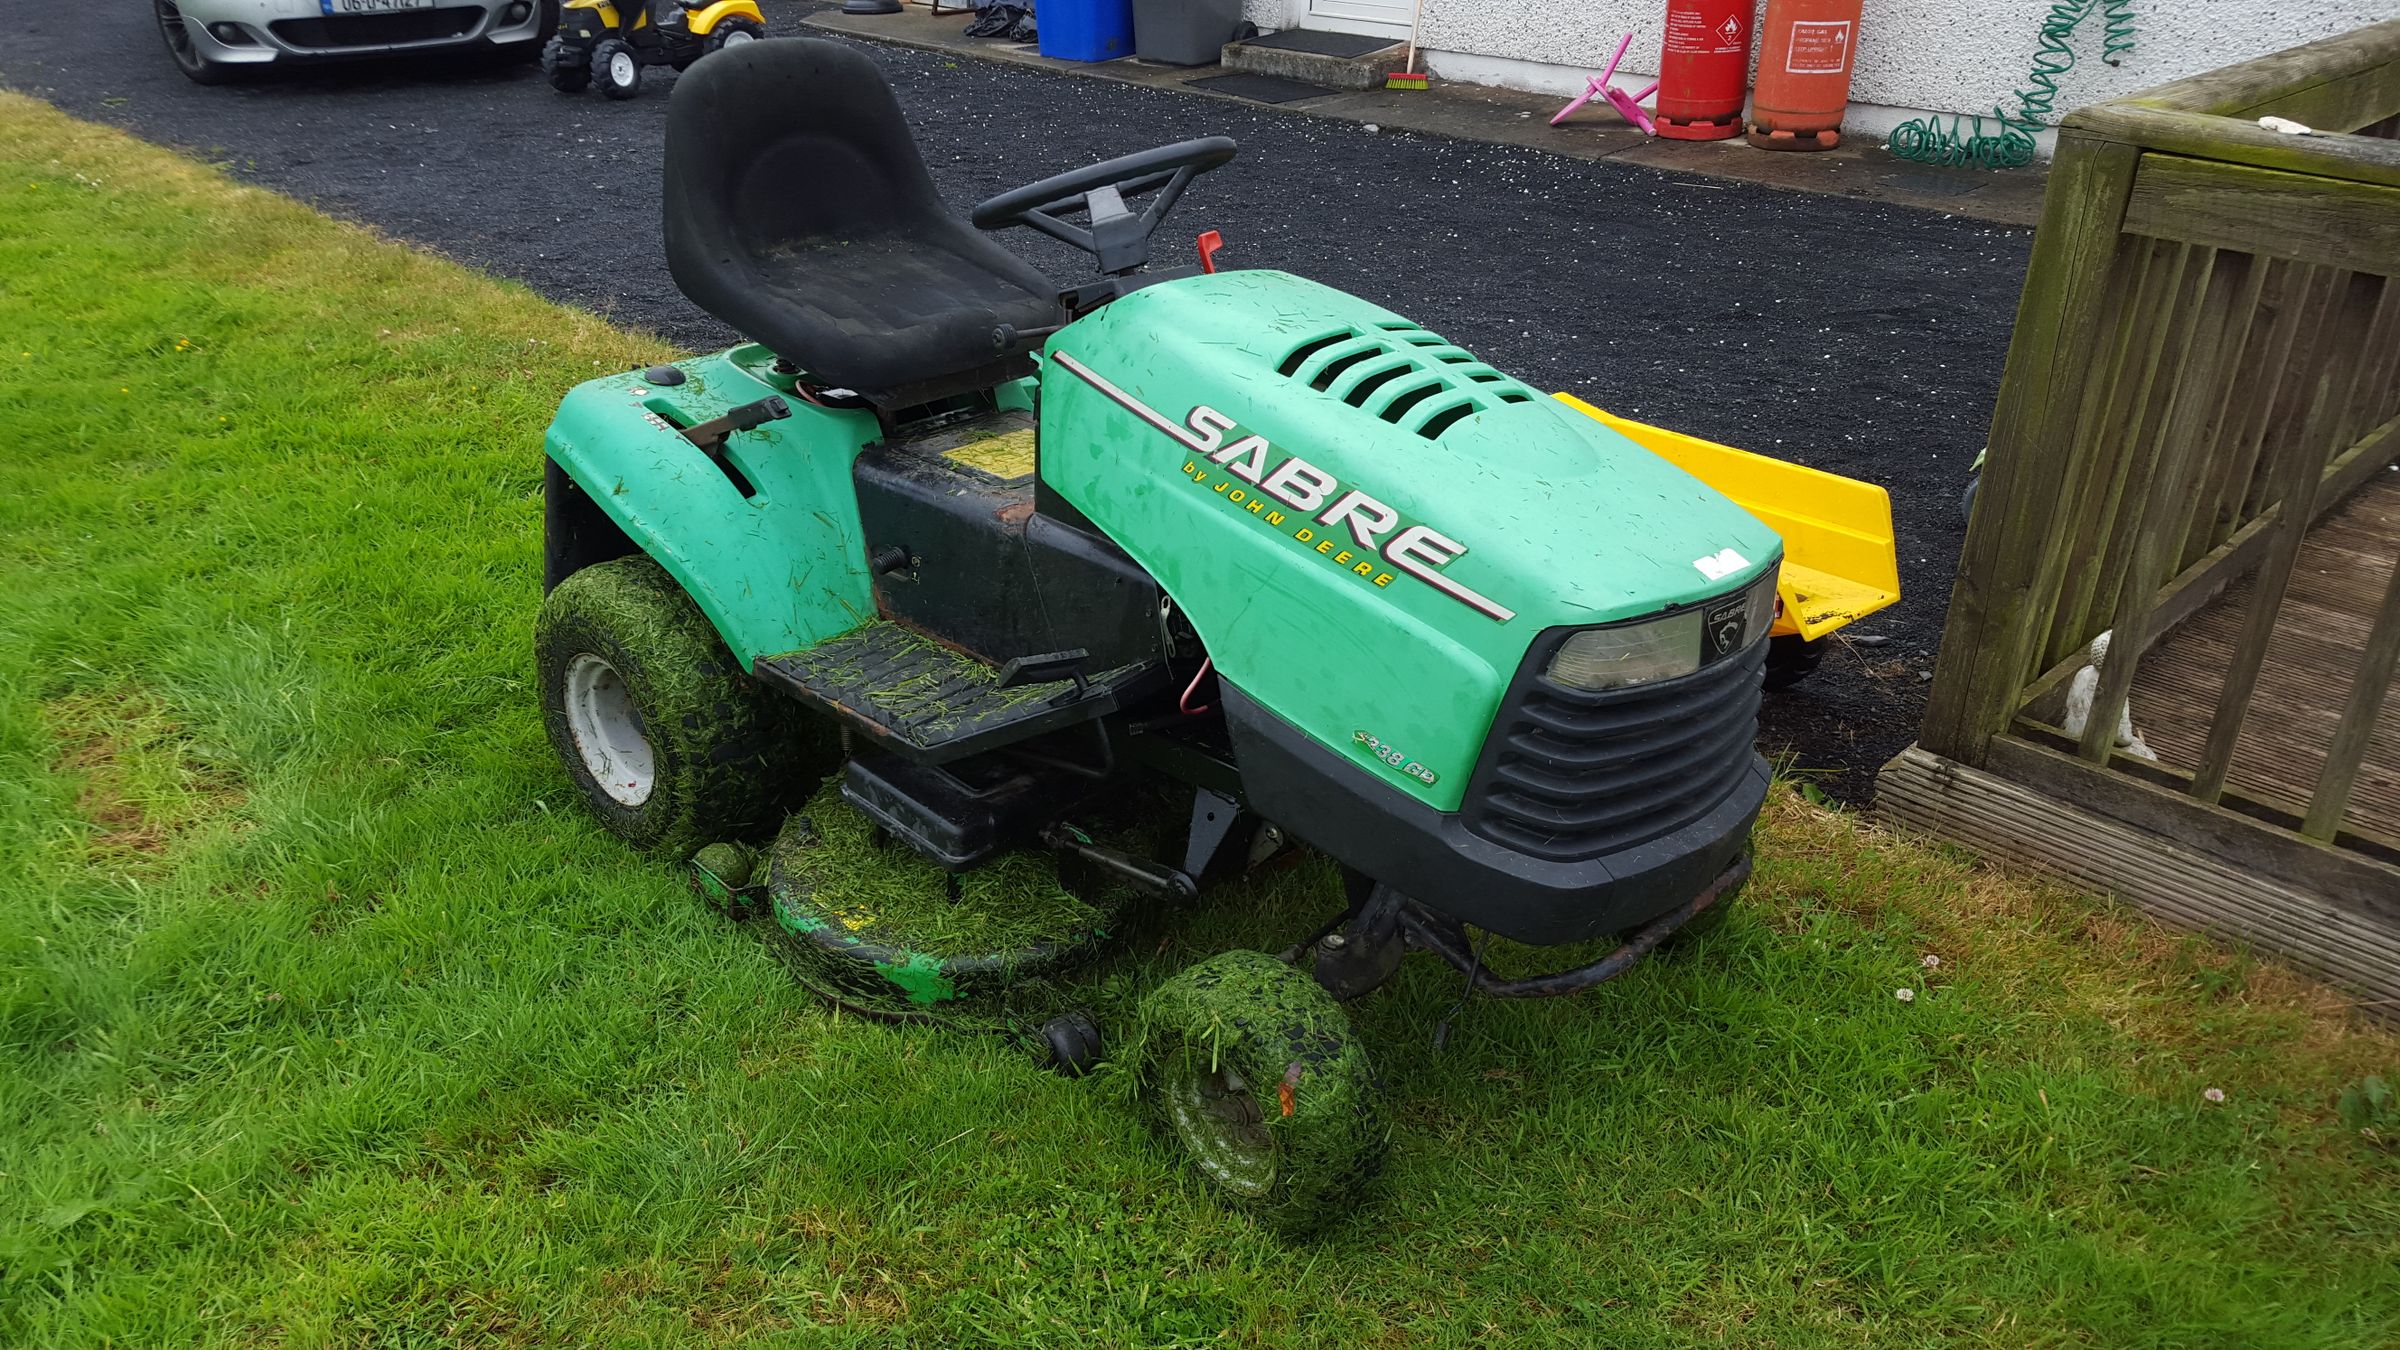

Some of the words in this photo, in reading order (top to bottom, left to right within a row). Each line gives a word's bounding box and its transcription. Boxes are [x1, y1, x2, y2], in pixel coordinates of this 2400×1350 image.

[1182, 461, 1207, 482] by
[1213, 481, 1286, 526] JOHN
[1293, 527, 1394, 587] DEERE
[1185, 405, 1470, 574] SABRE
[1713, 603, 1745, 621] SABRE
